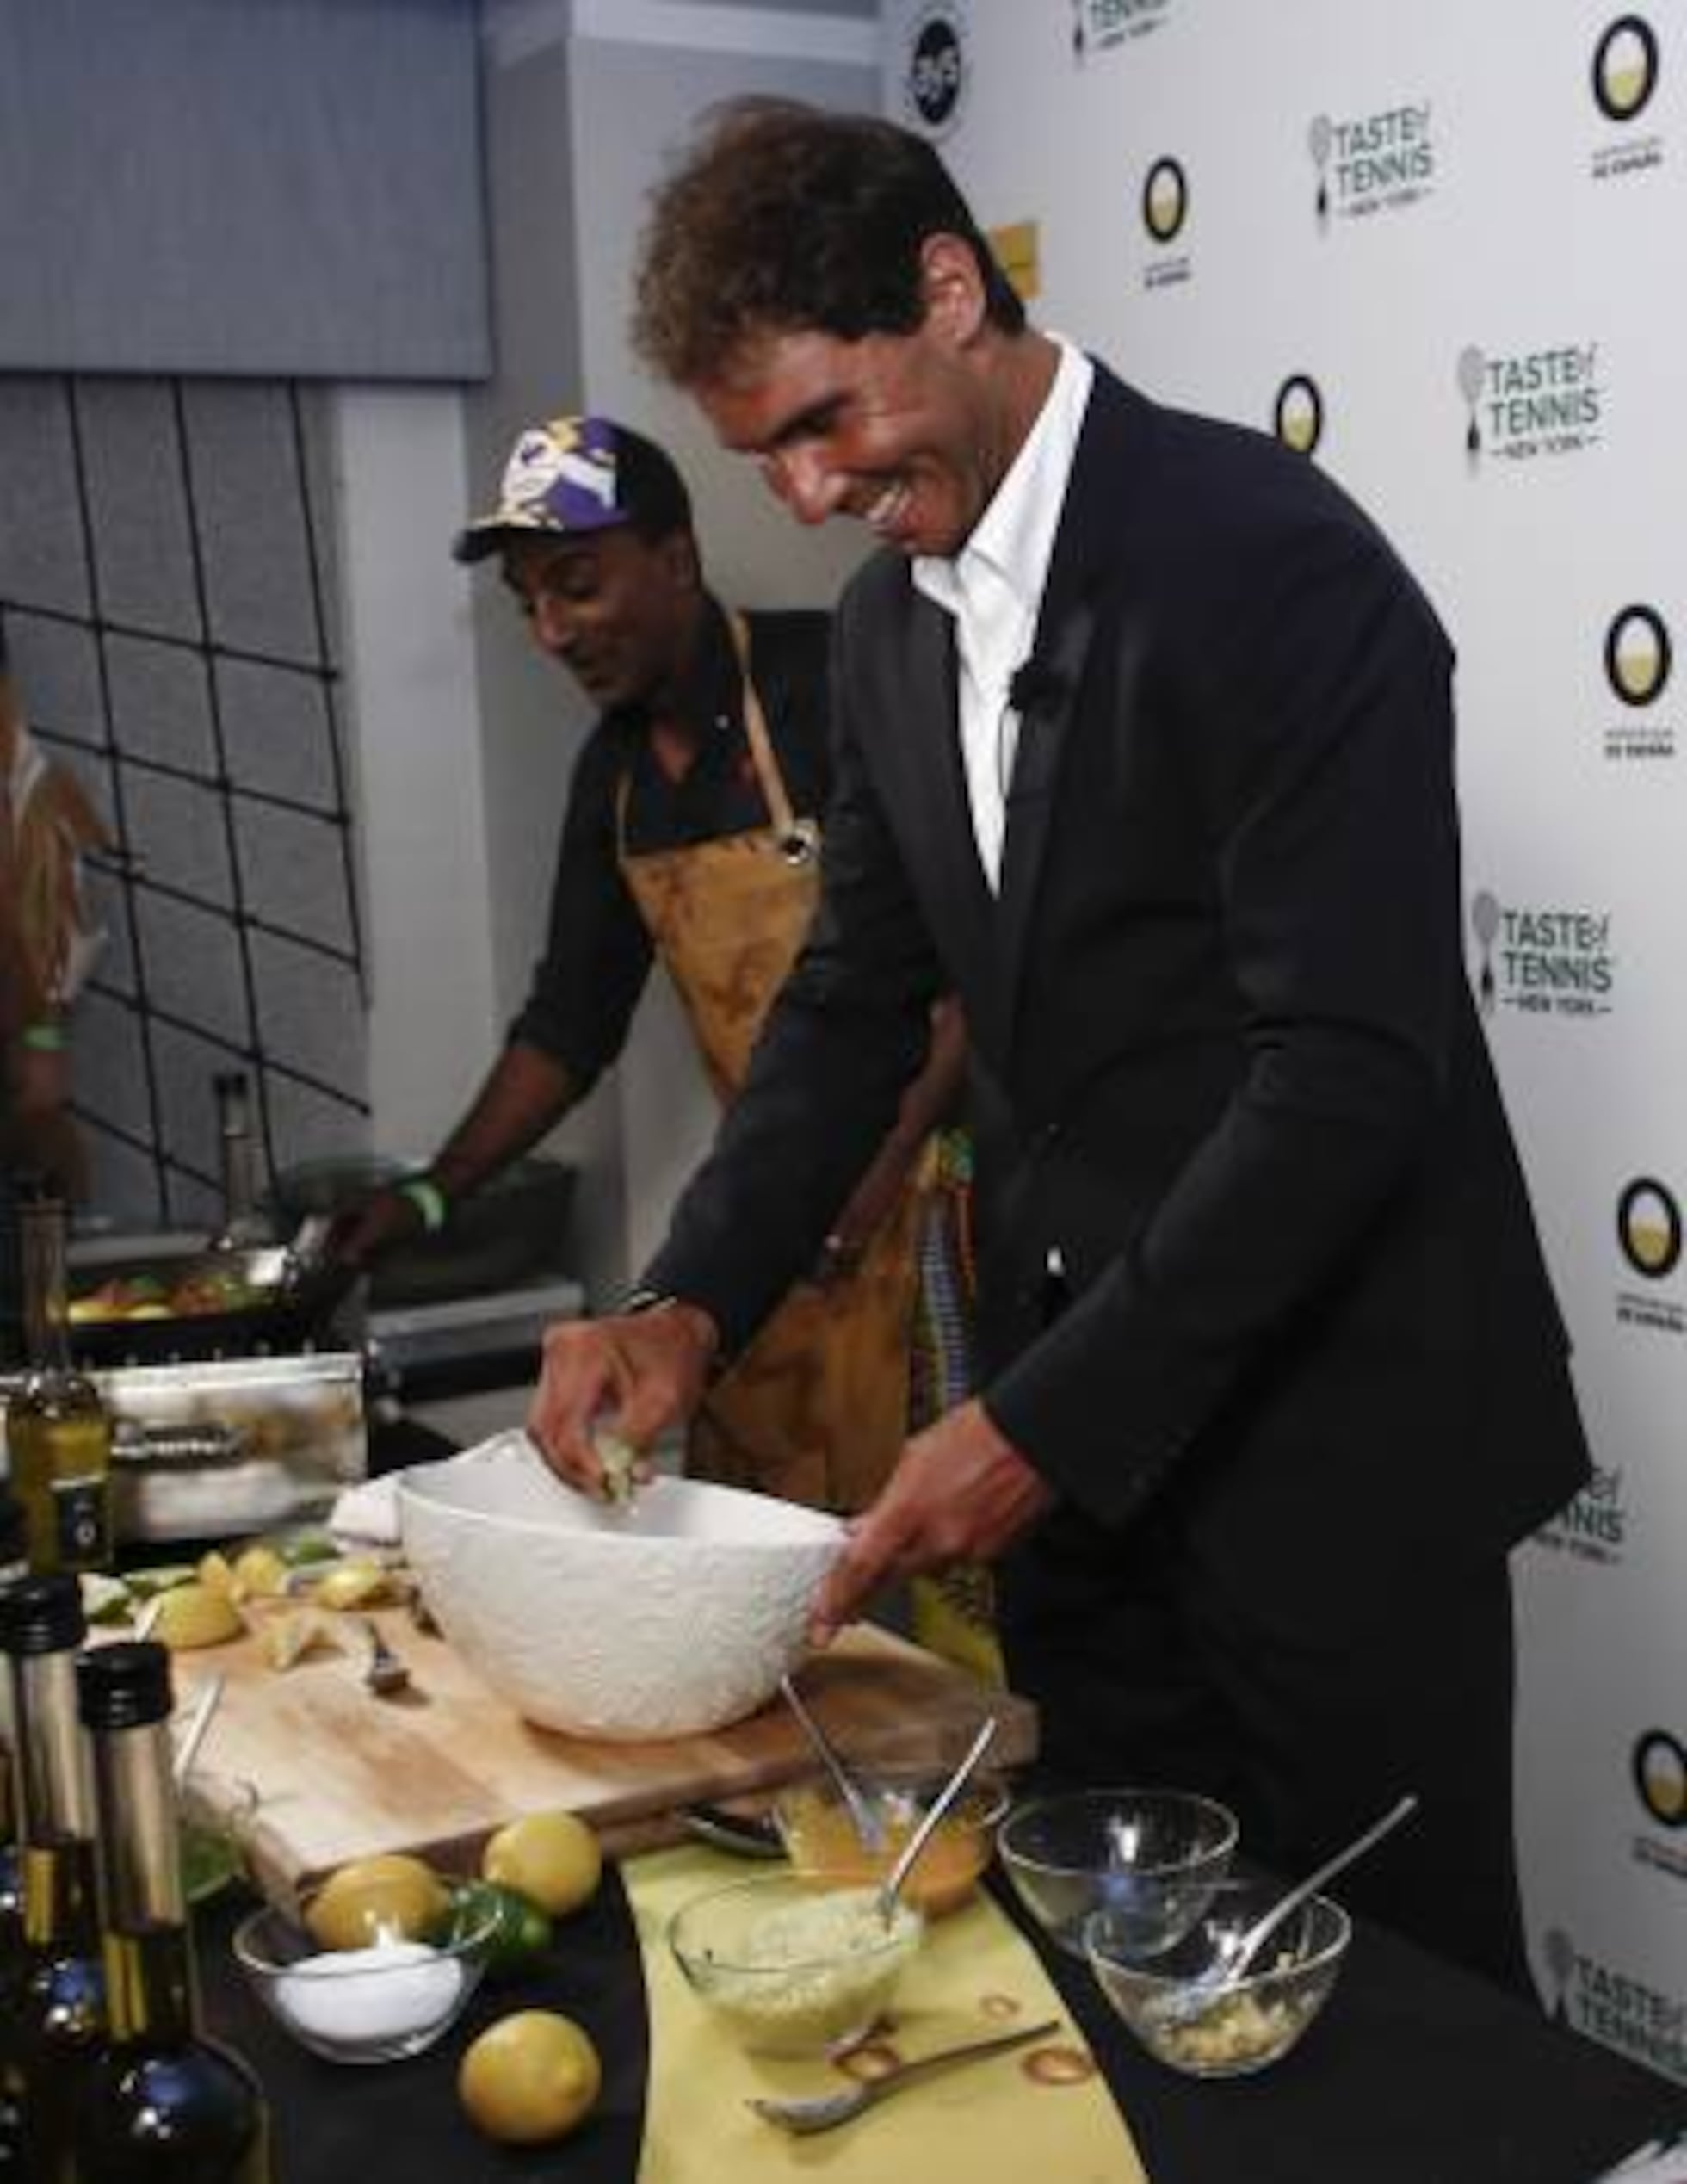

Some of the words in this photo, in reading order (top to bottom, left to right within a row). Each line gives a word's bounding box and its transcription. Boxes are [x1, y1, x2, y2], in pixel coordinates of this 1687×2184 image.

[1333, 106, 1418, 157] TASTE
[1335, 145, 1432, 197] TENNIS
[1487, 347, 1577, 396] TASTE
[1490, 387, 1600, 437] TENNIS
[1504, 913, 1591, 948] TASTE
[1503, 950, 1613, 994] TENNIS
